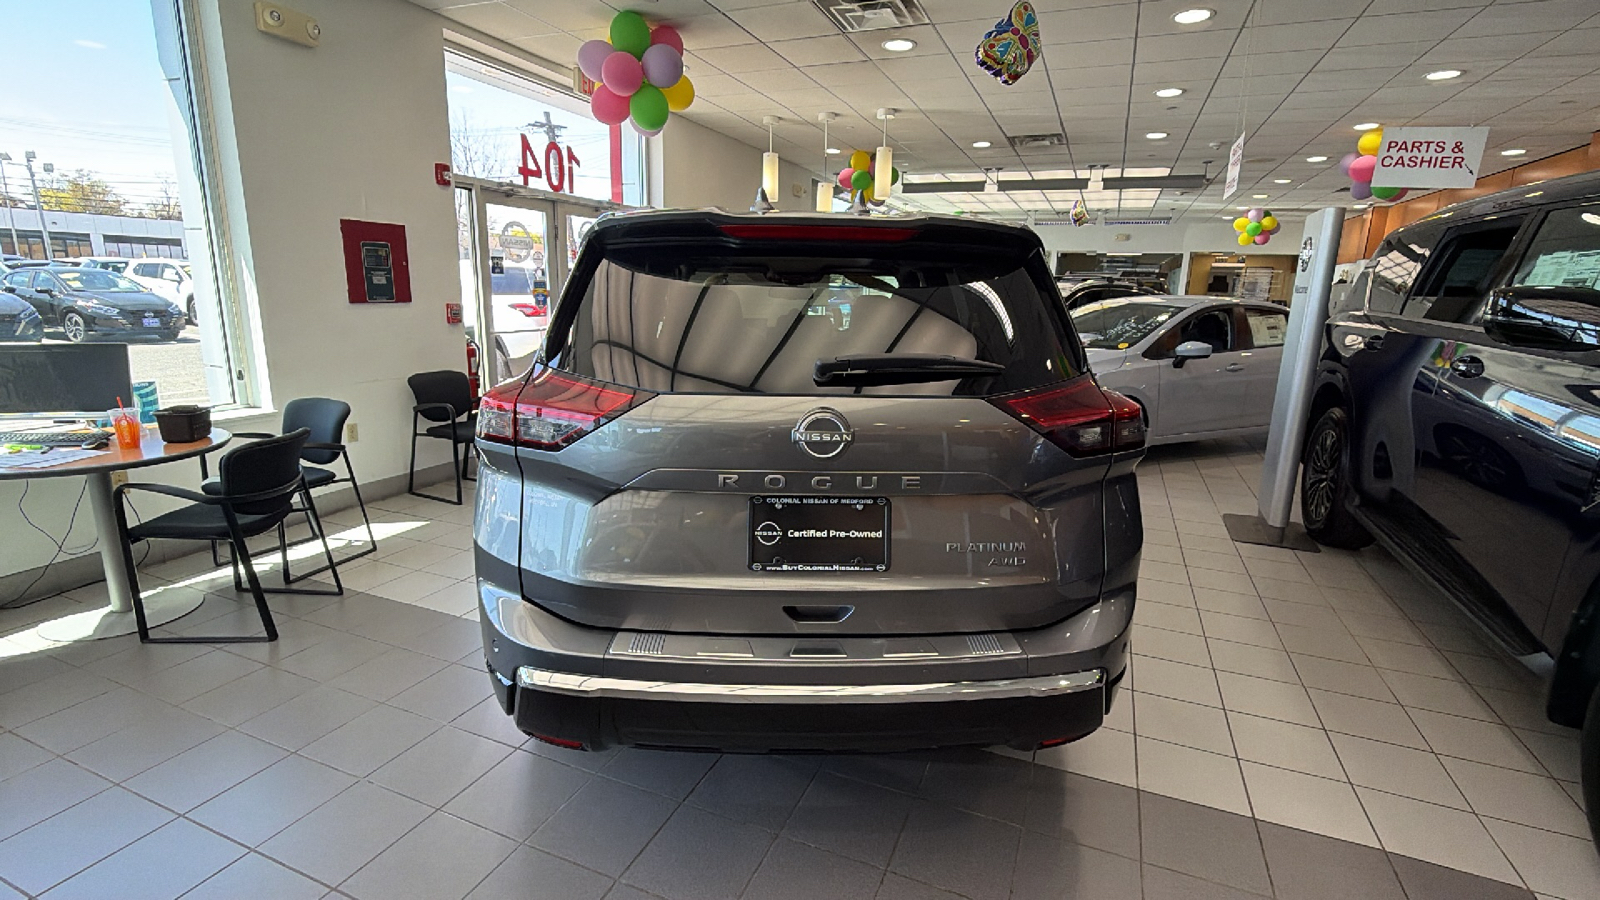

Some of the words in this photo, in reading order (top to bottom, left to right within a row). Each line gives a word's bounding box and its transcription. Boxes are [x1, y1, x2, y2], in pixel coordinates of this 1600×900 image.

[1386, 141, 1446, 153] PARTS
[1451, 141, 1464, 153] &
[1381, 155, 1465, 168] CASHIER
[796, 433, 851, 441] NISSAN
[718, 474, 920, 489] ROGUE
[788, 530, 828, 538] Certified
[829, 530, 883, 538] Pre-Owned
[946, 542, 1026, 553] PLATINUM
[987, 556, 1026, 567] AWD
